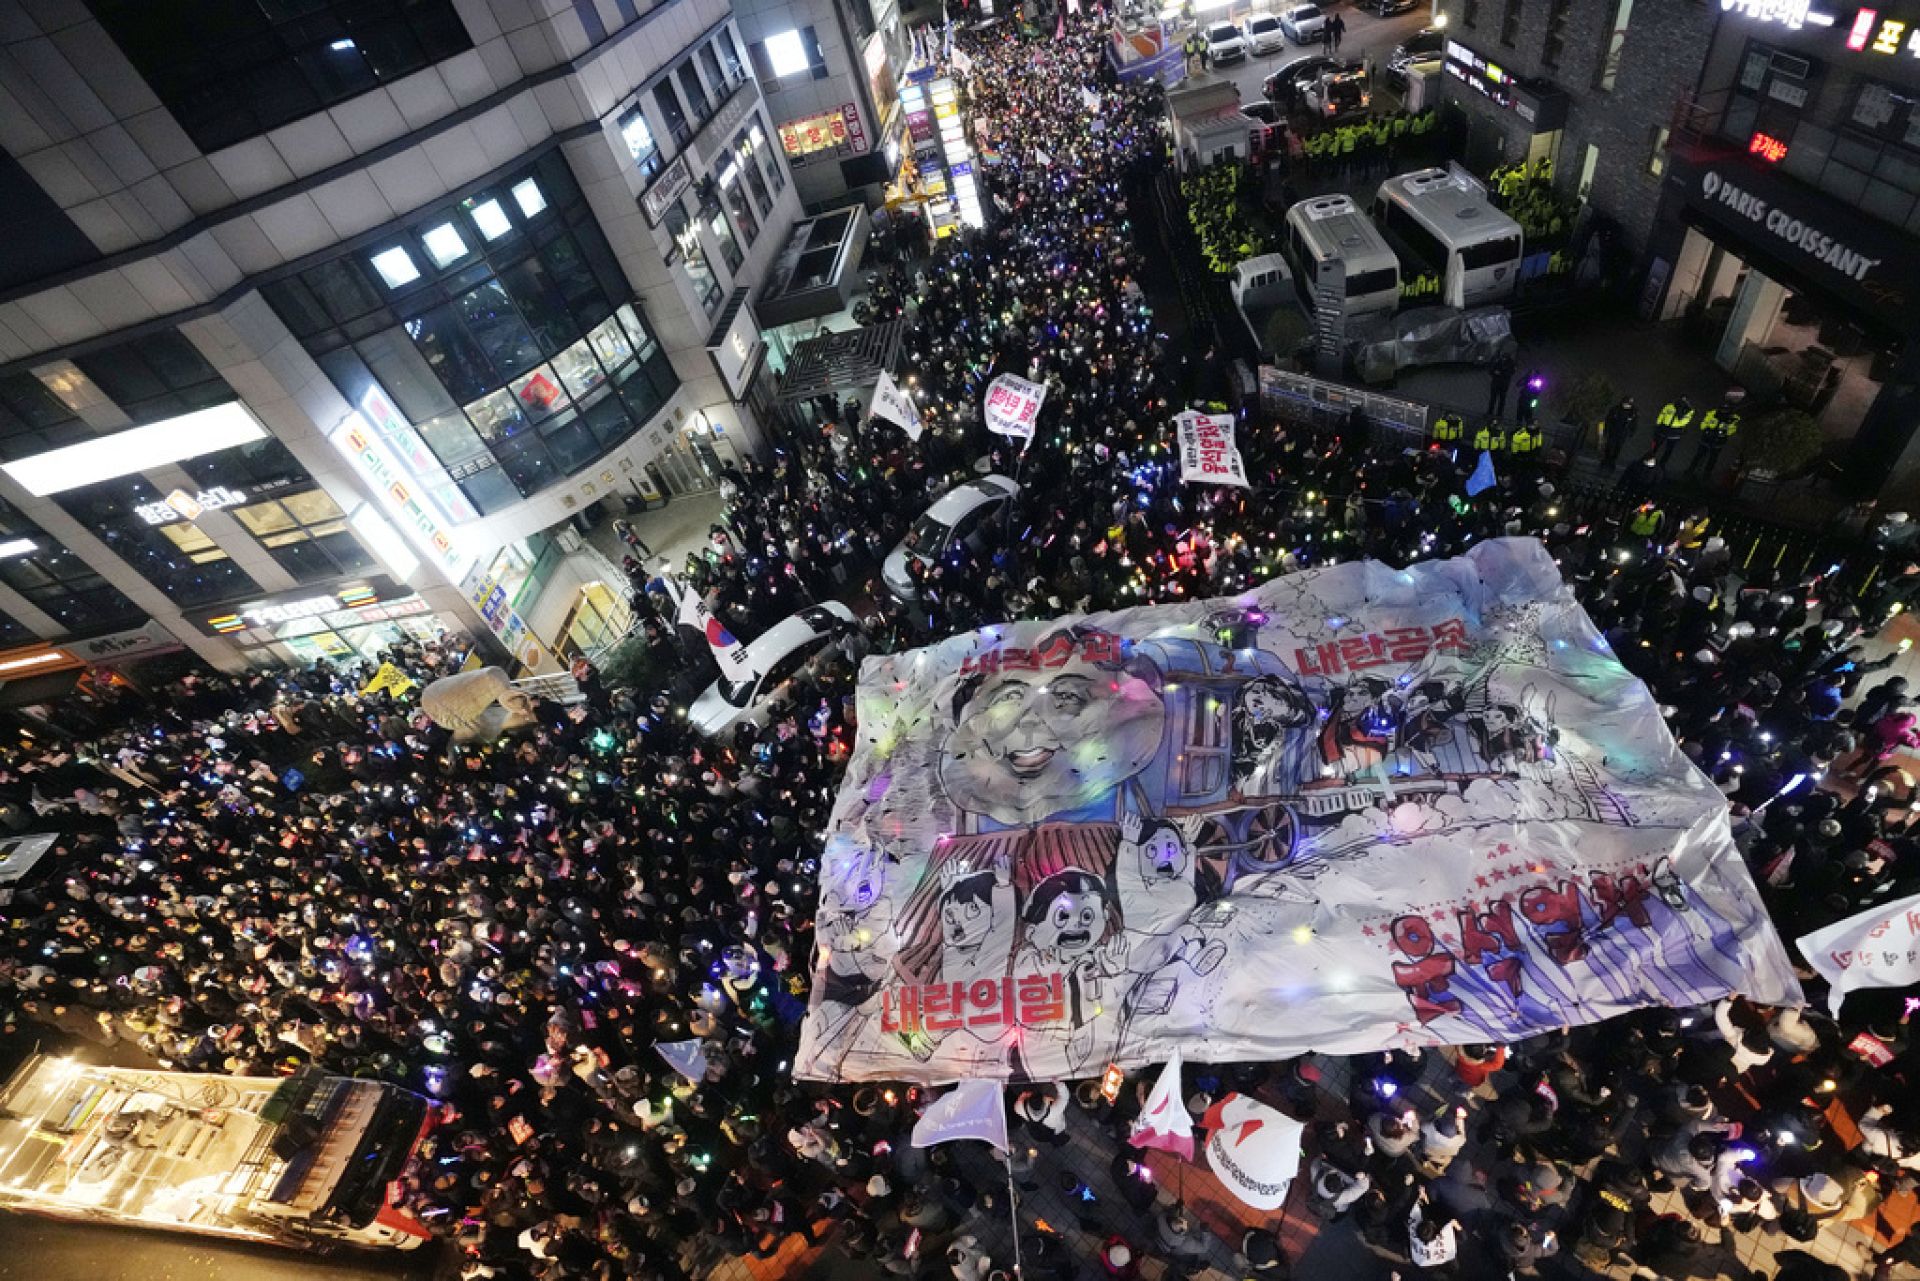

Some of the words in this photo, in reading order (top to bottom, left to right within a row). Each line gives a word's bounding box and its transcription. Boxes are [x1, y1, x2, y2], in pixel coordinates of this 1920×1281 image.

[1719, 181, 1768, 222] PARIS
[1766, 208, 1882, 281] CROISSANT
[880, 973, 1064, 1033] 내란의힘
